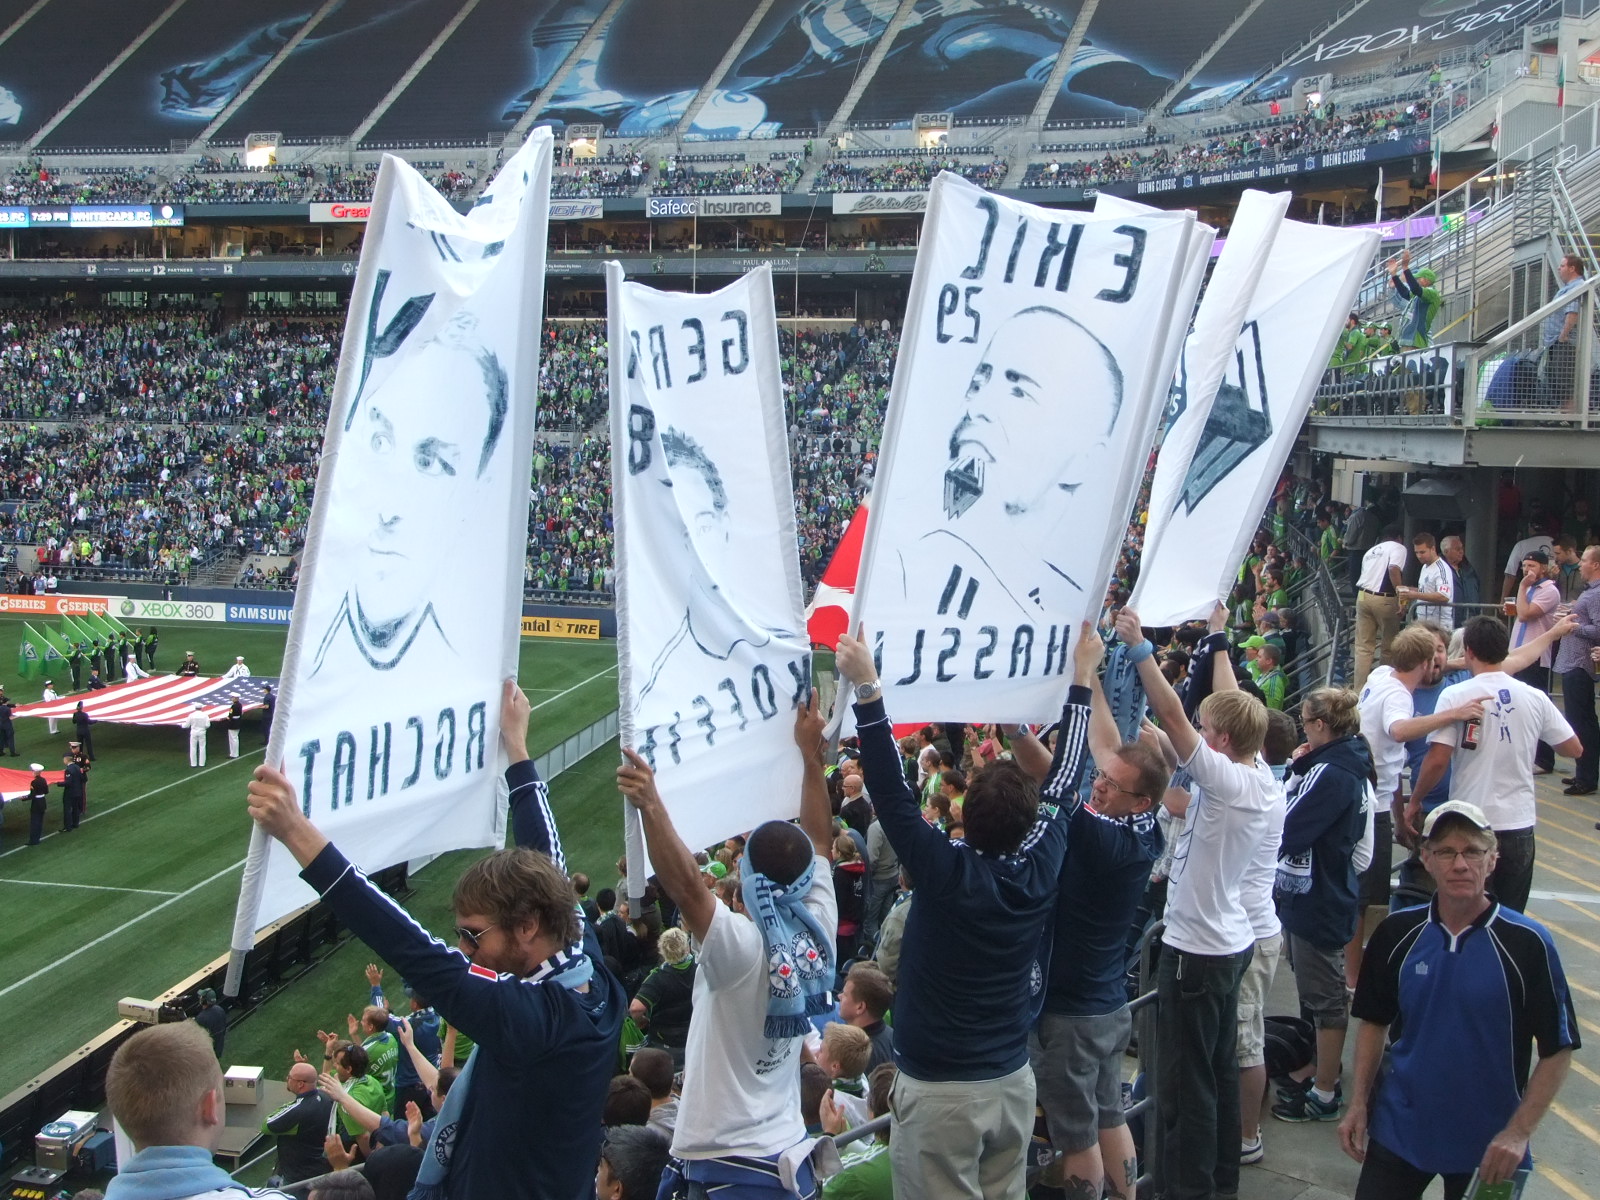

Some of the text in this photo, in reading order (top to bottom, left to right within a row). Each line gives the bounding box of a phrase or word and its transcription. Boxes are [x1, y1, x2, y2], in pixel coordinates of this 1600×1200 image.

[920, 114, 948, 123] 340
[573, 126, 597, 134] 338
[254, 134, 277, 142] 336
[1342, 148, 1366, 164] CLASSIC
[1155, 178, 1177, 192] CLASSIC
[703, 199, 772, 215] Insurance
[72, 211, 134, 222] WHITECAPS
[9, 598, 47, 610] SERIES
[141, 602, 215, 619] XBOX 360
[566, 623, 598, 635] TIRE
